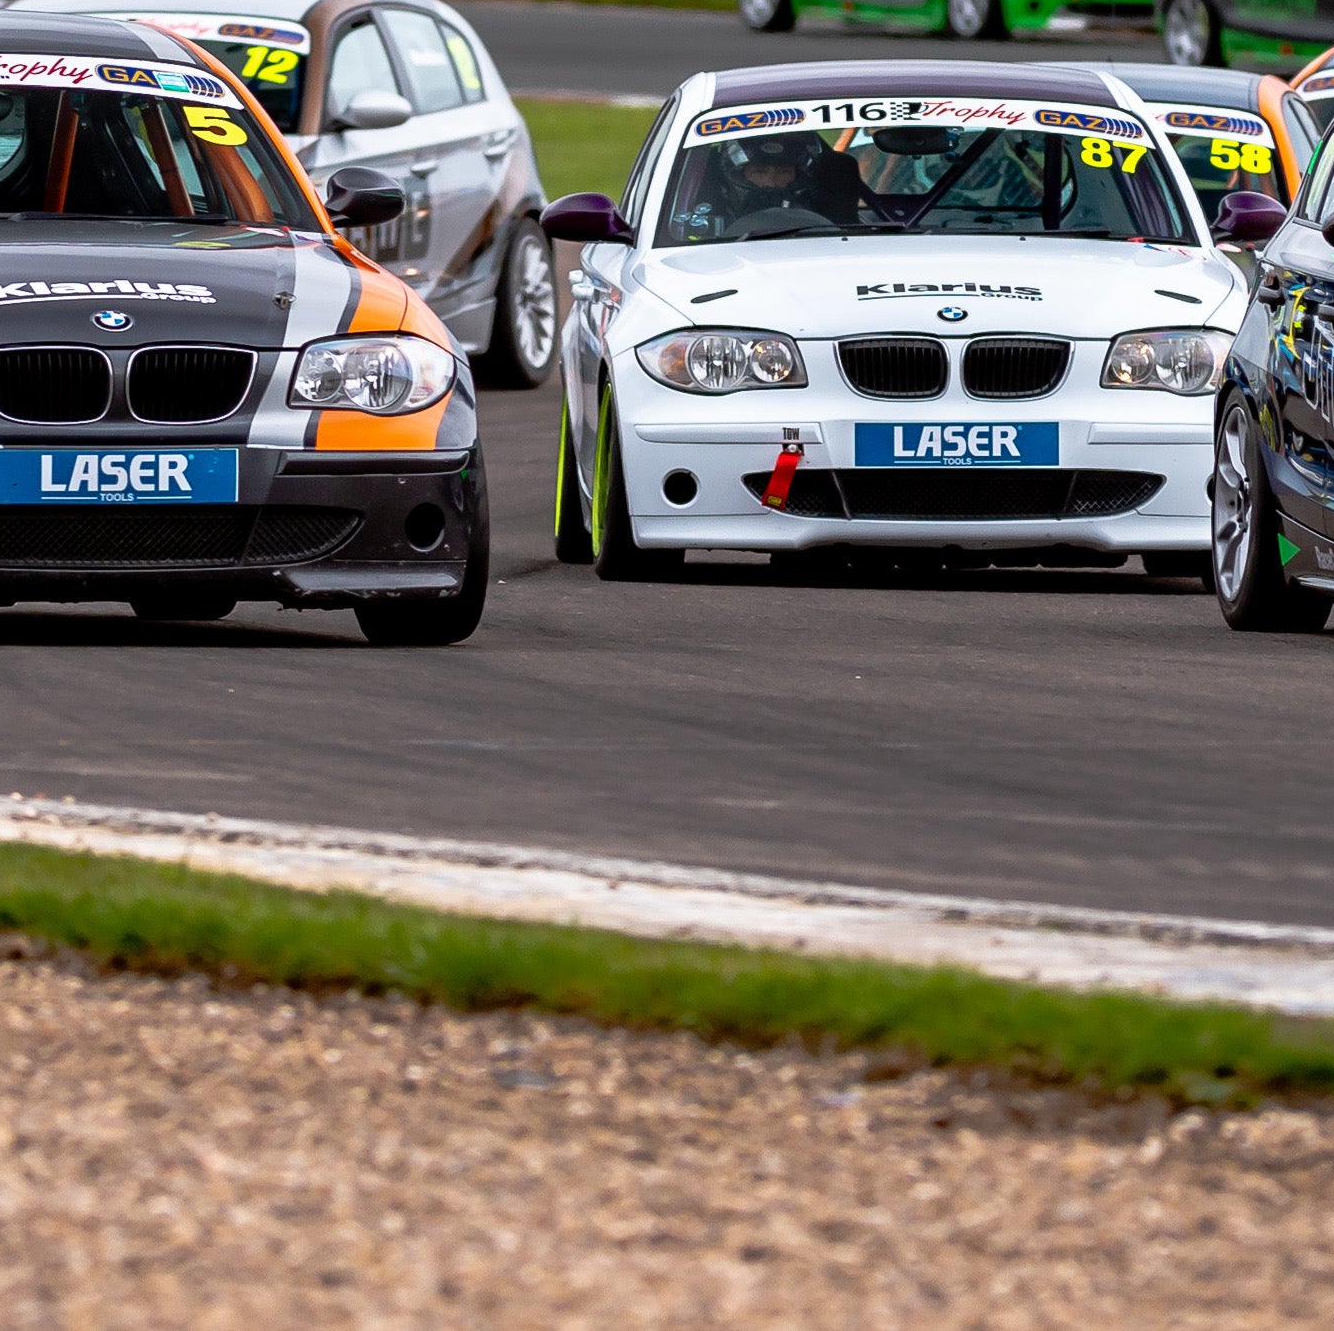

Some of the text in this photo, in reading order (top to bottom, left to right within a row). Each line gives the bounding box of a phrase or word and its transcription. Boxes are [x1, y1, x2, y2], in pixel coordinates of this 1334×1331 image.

[241, 46, 299, 84] 12
[102, 66, 158, 87] GA
[811, 100, 1028, 124] 116 Trophy
[1039, 110, 1107, 132] GAZ
[1170, 113, 1229, 130] GAZ
[182, 106, 248, 146] 5
[701, 113, 766, 134] GAZ
[1080, 137, 1148, 174] 87
[1210, 139, 1271, 174] 58
[140, 293, 217, 304] Group
[856, 283, 1042, 296] Klarius
[981, 292, 1043, 302] Group
[782, 427, 800, 441] TOW
[894, 426, 1022, 457] LASER
[943, 457, 972, 465] TOOLS
[40, 454, 193, 492] LASER
[100, 493, 135, 502] TOOLS
